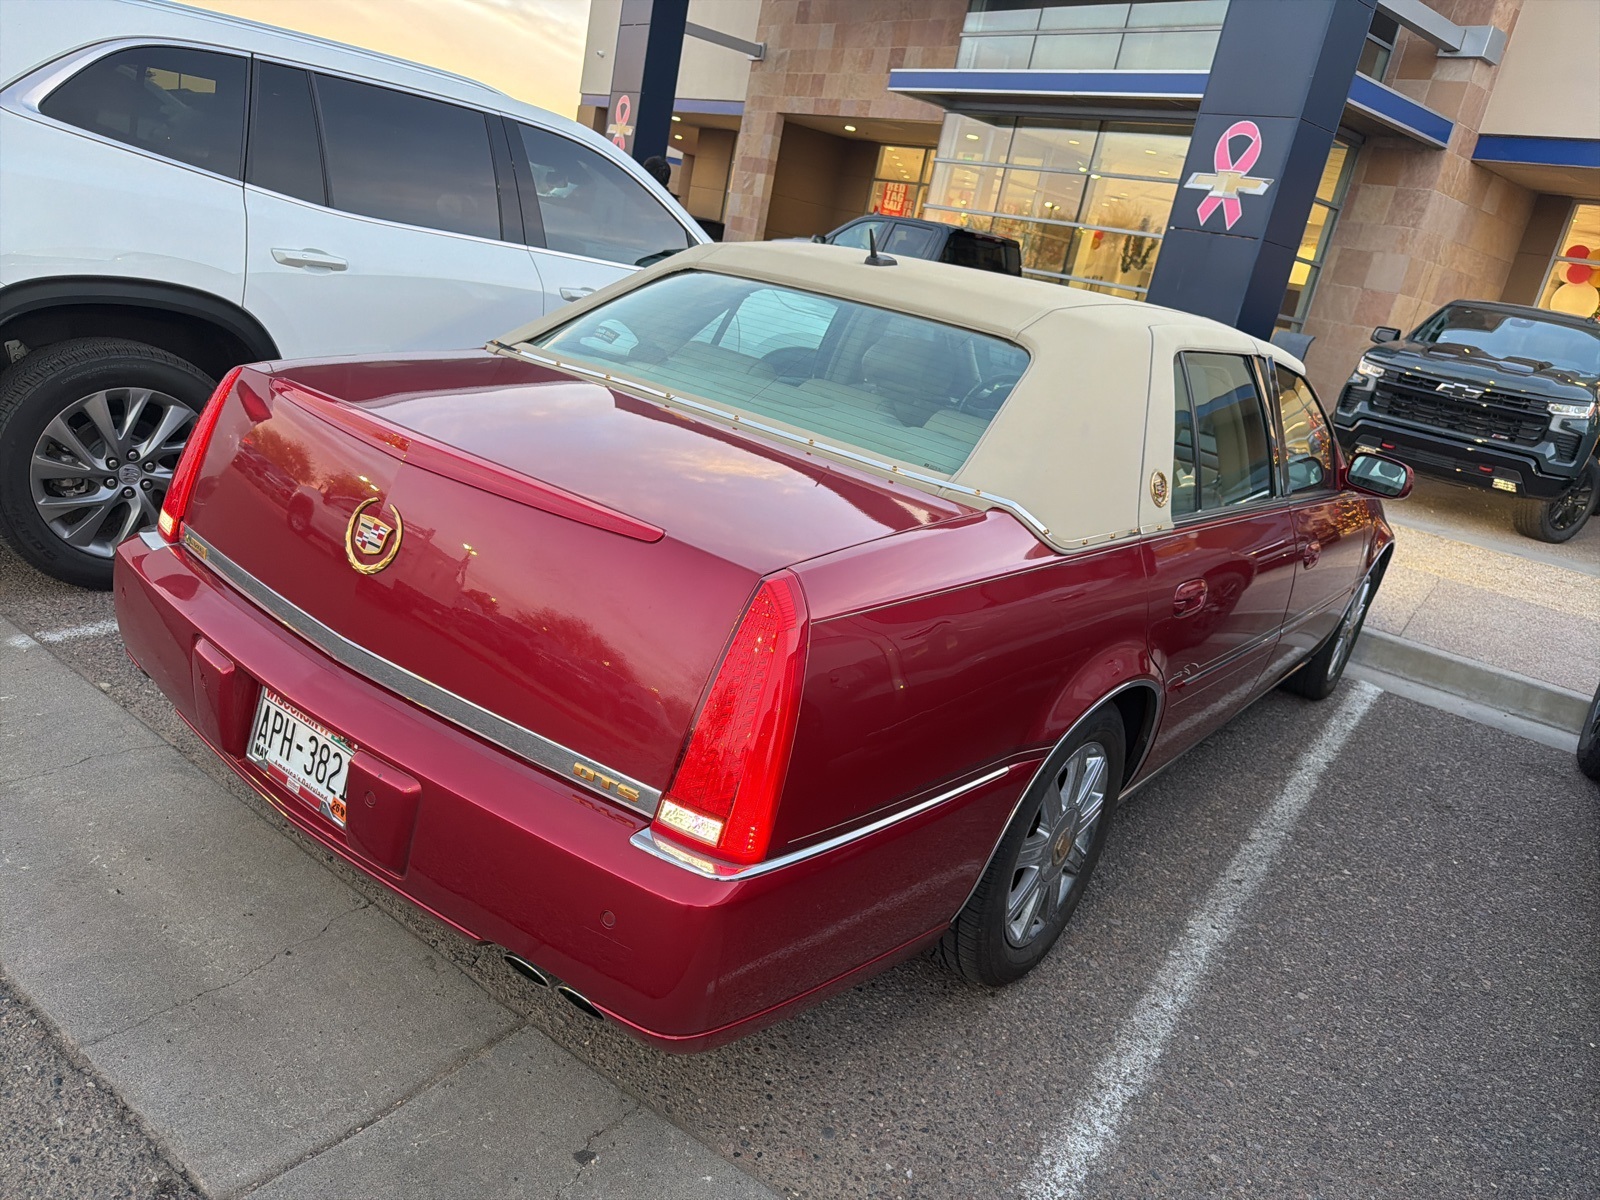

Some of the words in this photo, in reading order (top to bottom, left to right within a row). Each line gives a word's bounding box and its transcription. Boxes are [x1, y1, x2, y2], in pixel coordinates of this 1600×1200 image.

[886, 183, 906, 193] RED
[885, 190, 905, 203] TAG
[883, 199, 903, 211] SALE
[253, 742, 269, 760] MAY
[274, 759, 302, 782] America's
[301, 777, 329, 802] Dairyland
[331, 800, 341, 814] 26
